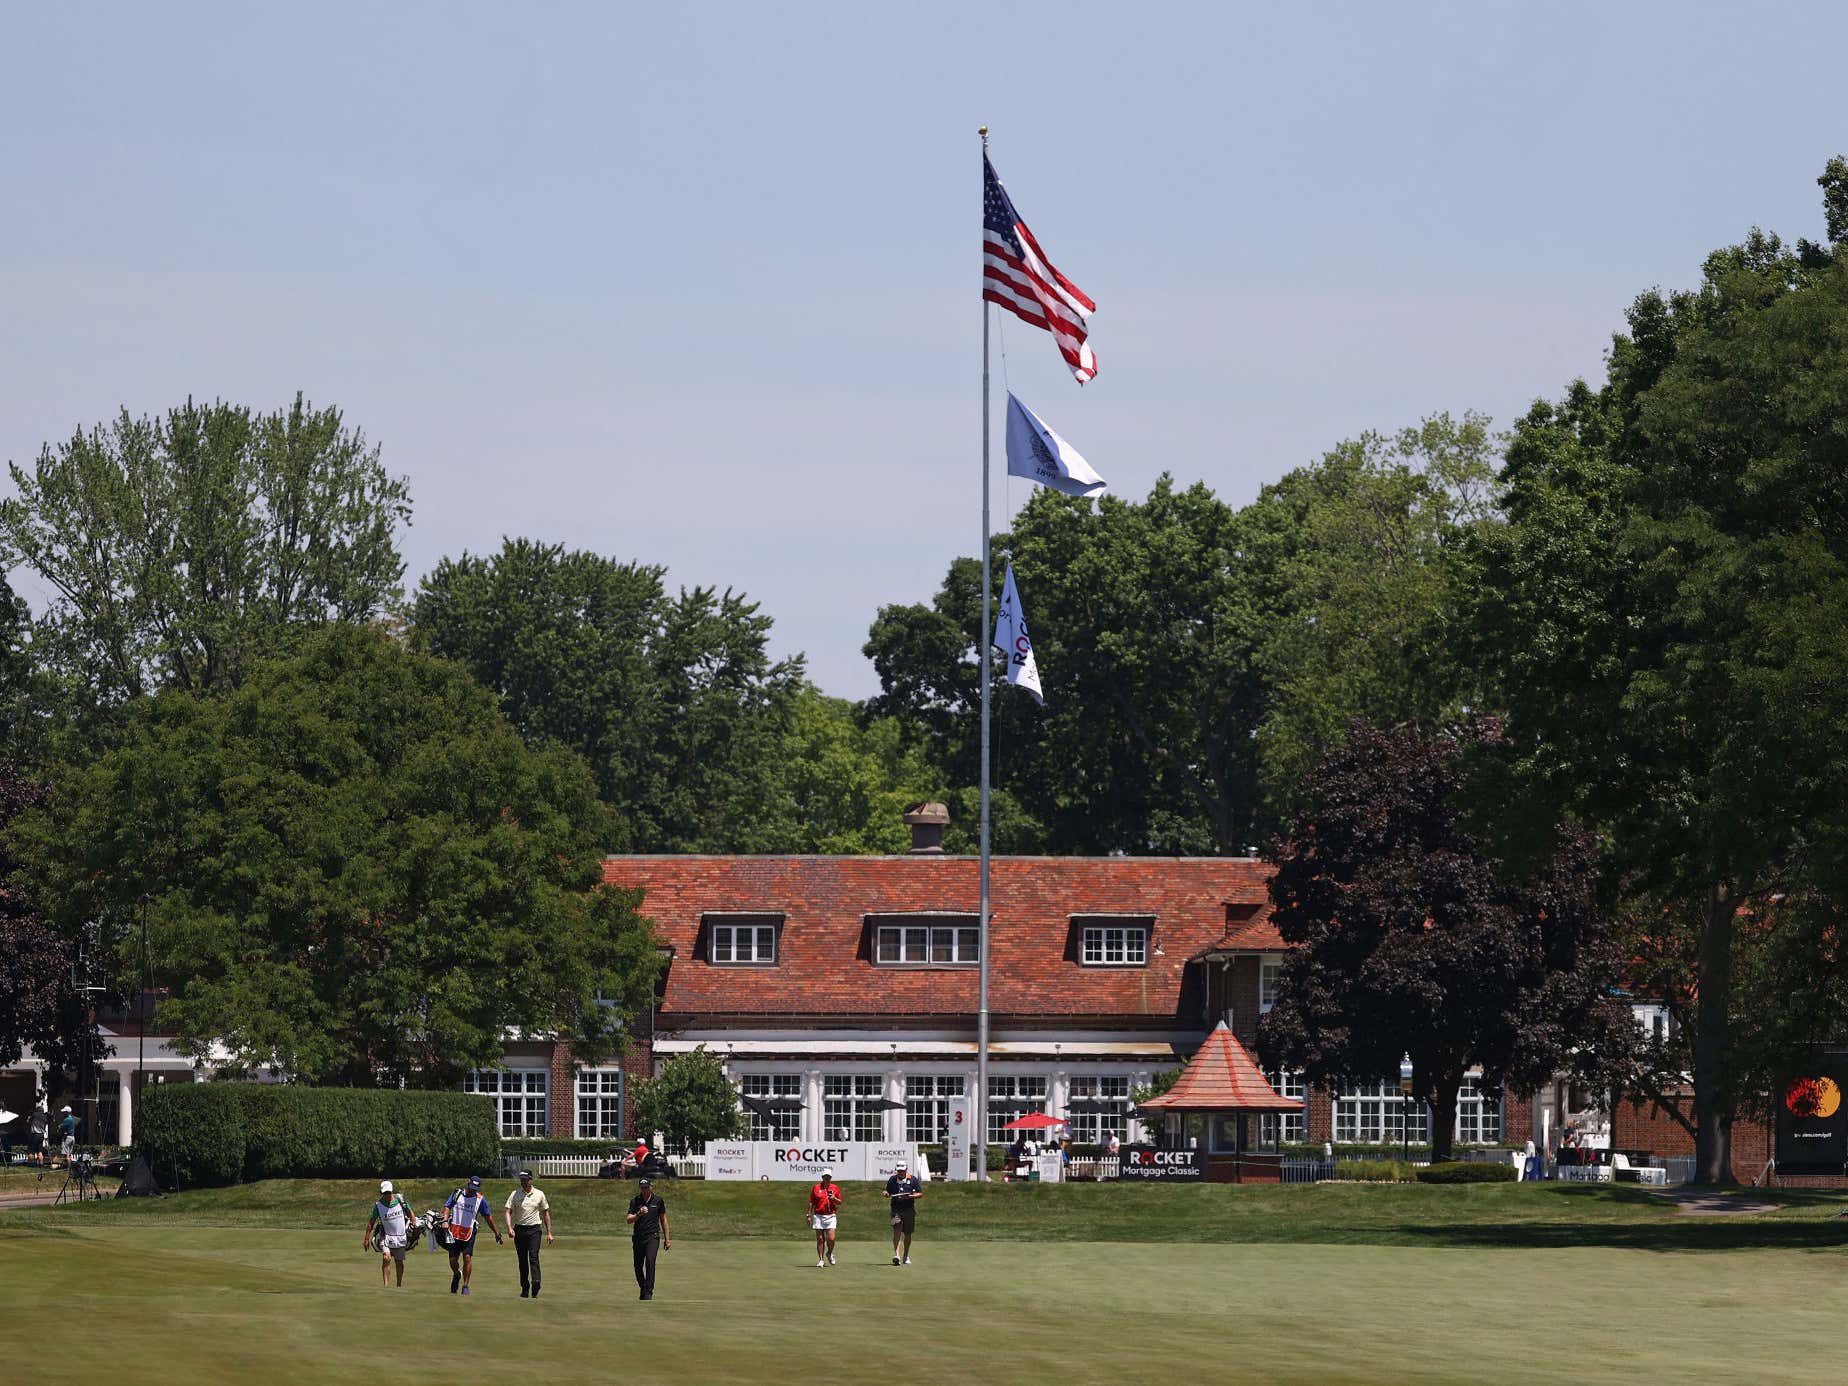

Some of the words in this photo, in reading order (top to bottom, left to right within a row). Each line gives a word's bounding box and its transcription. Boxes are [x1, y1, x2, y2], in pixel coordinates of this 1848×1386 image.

[955, 1111, 962, 1123] 3
[775, 1149, 848, 1162] ROCKET
[1130, 1151, 1194, 1165] ROCKET
[1122, 1166, 1166, 1177] Mortgage
[1167, 1166, 1200, 1175] Classic
